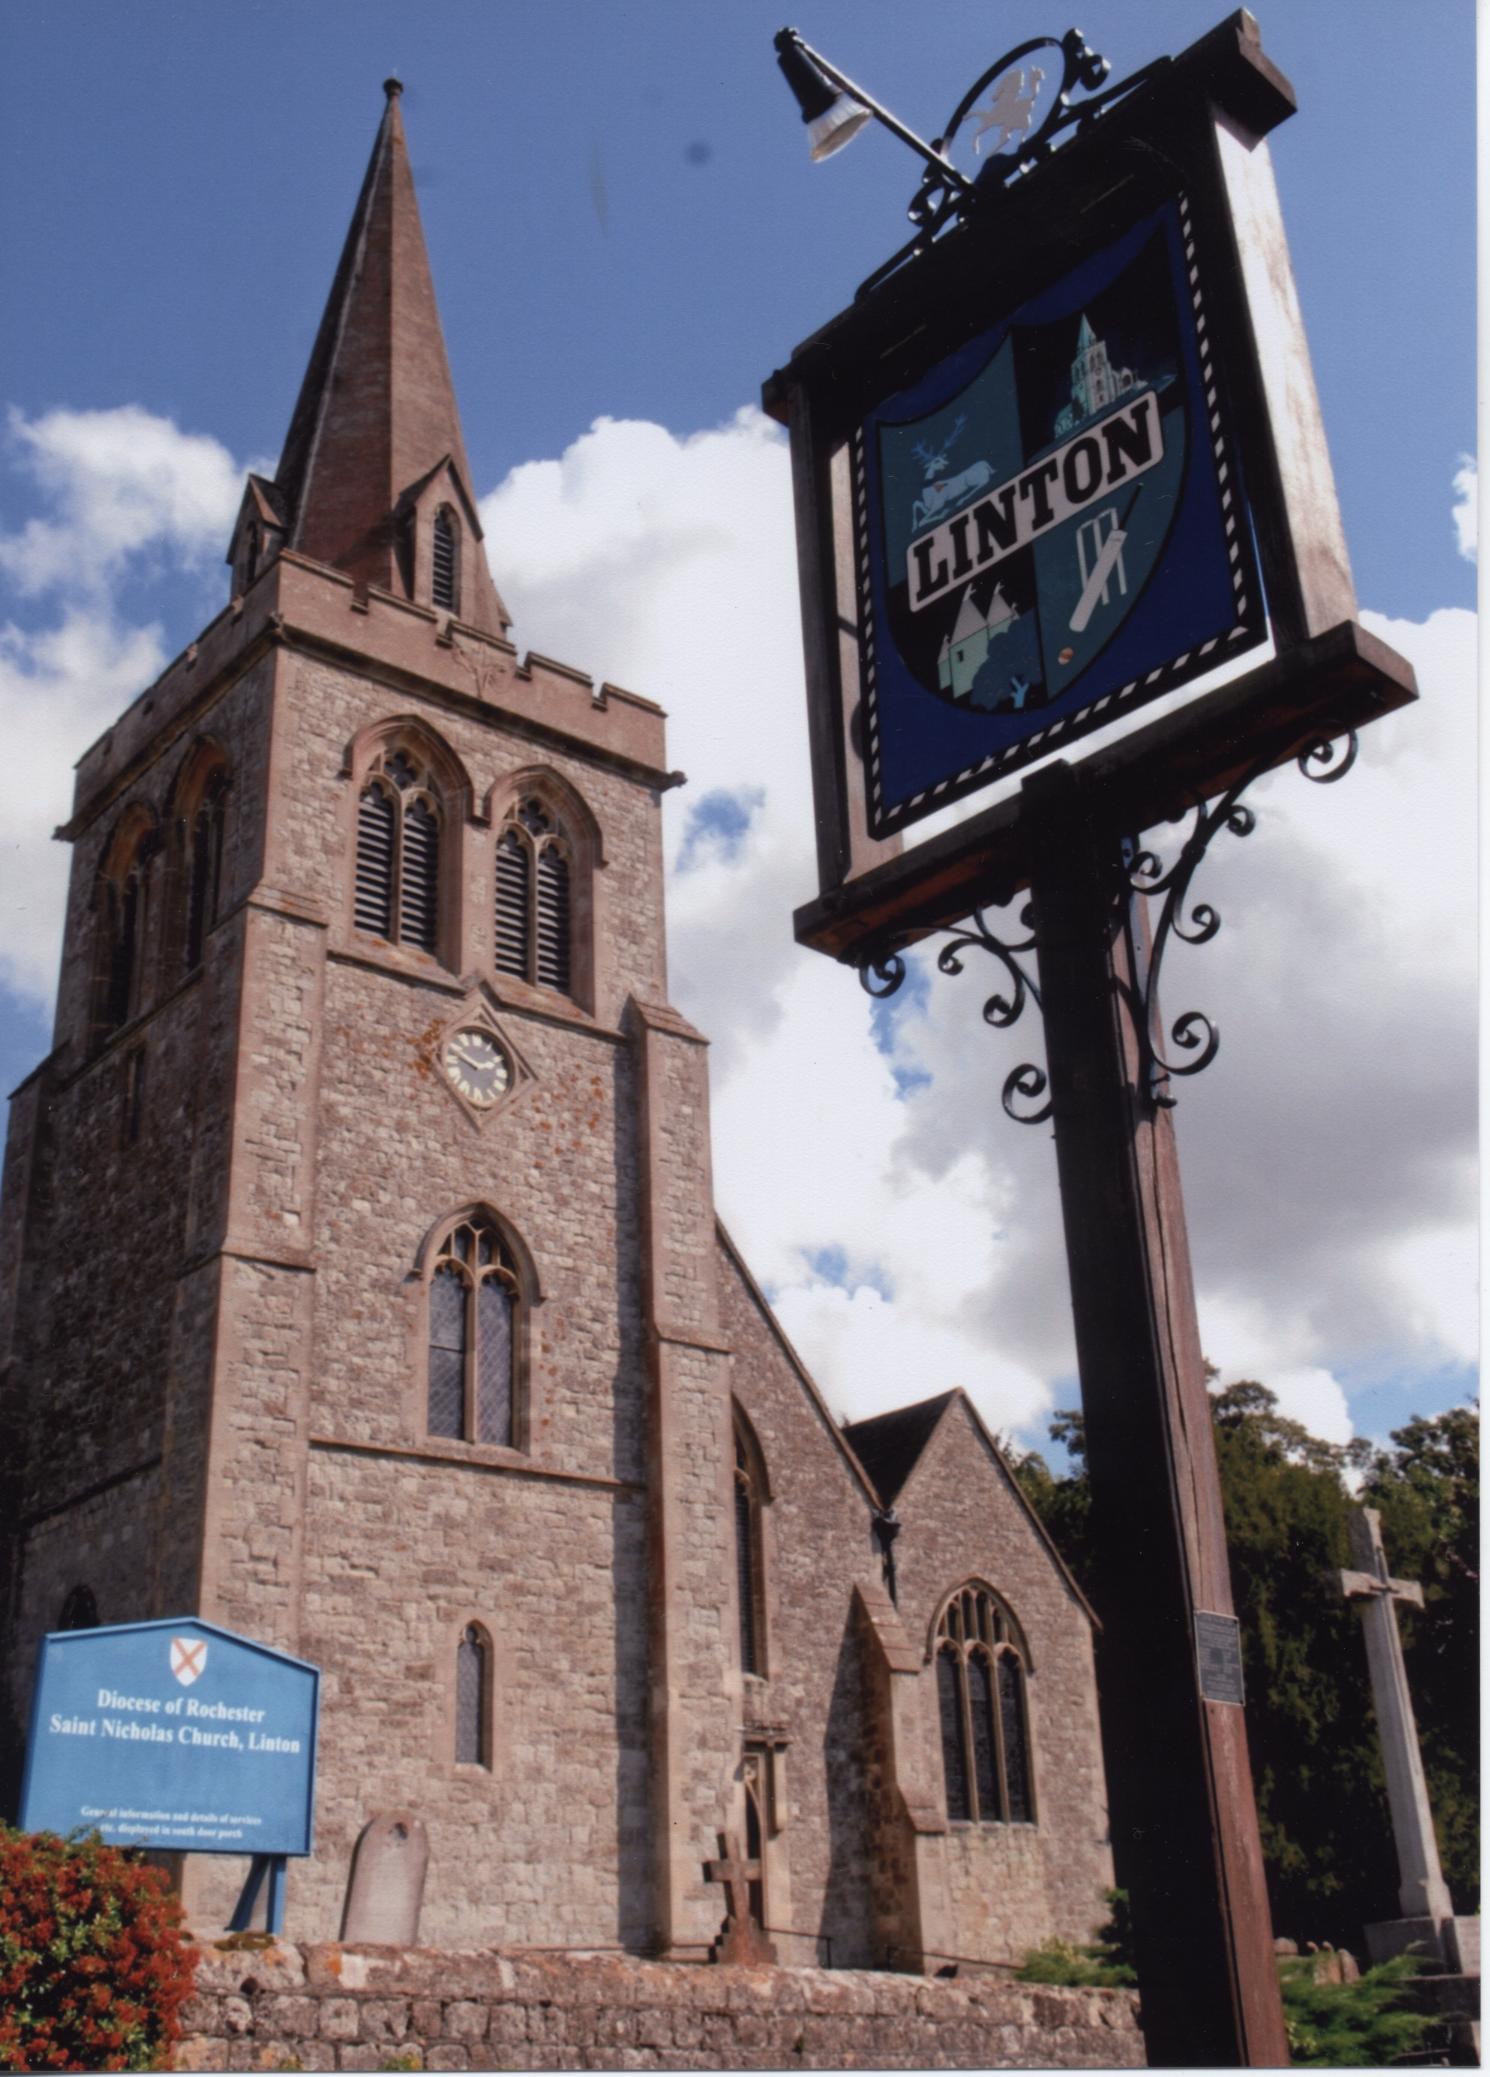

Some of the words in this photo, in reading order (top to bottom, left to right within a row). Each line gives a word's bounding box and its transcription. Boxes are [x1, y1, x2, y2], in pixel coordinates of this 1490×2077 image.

[913, 398, 1152, 601] LINTON
[97, 1688, 161, 1713] Diocese
[165, 1697, 184, 1715] of
[186, 1699, 265, 1722] Rochester
[49, 1713, 96, 1736] Saint
[100, 1718, 174, 1743] Nicholas
[178, 1726, 244, 1752] Church,
[248, 1732, 300, 1753] Linton
